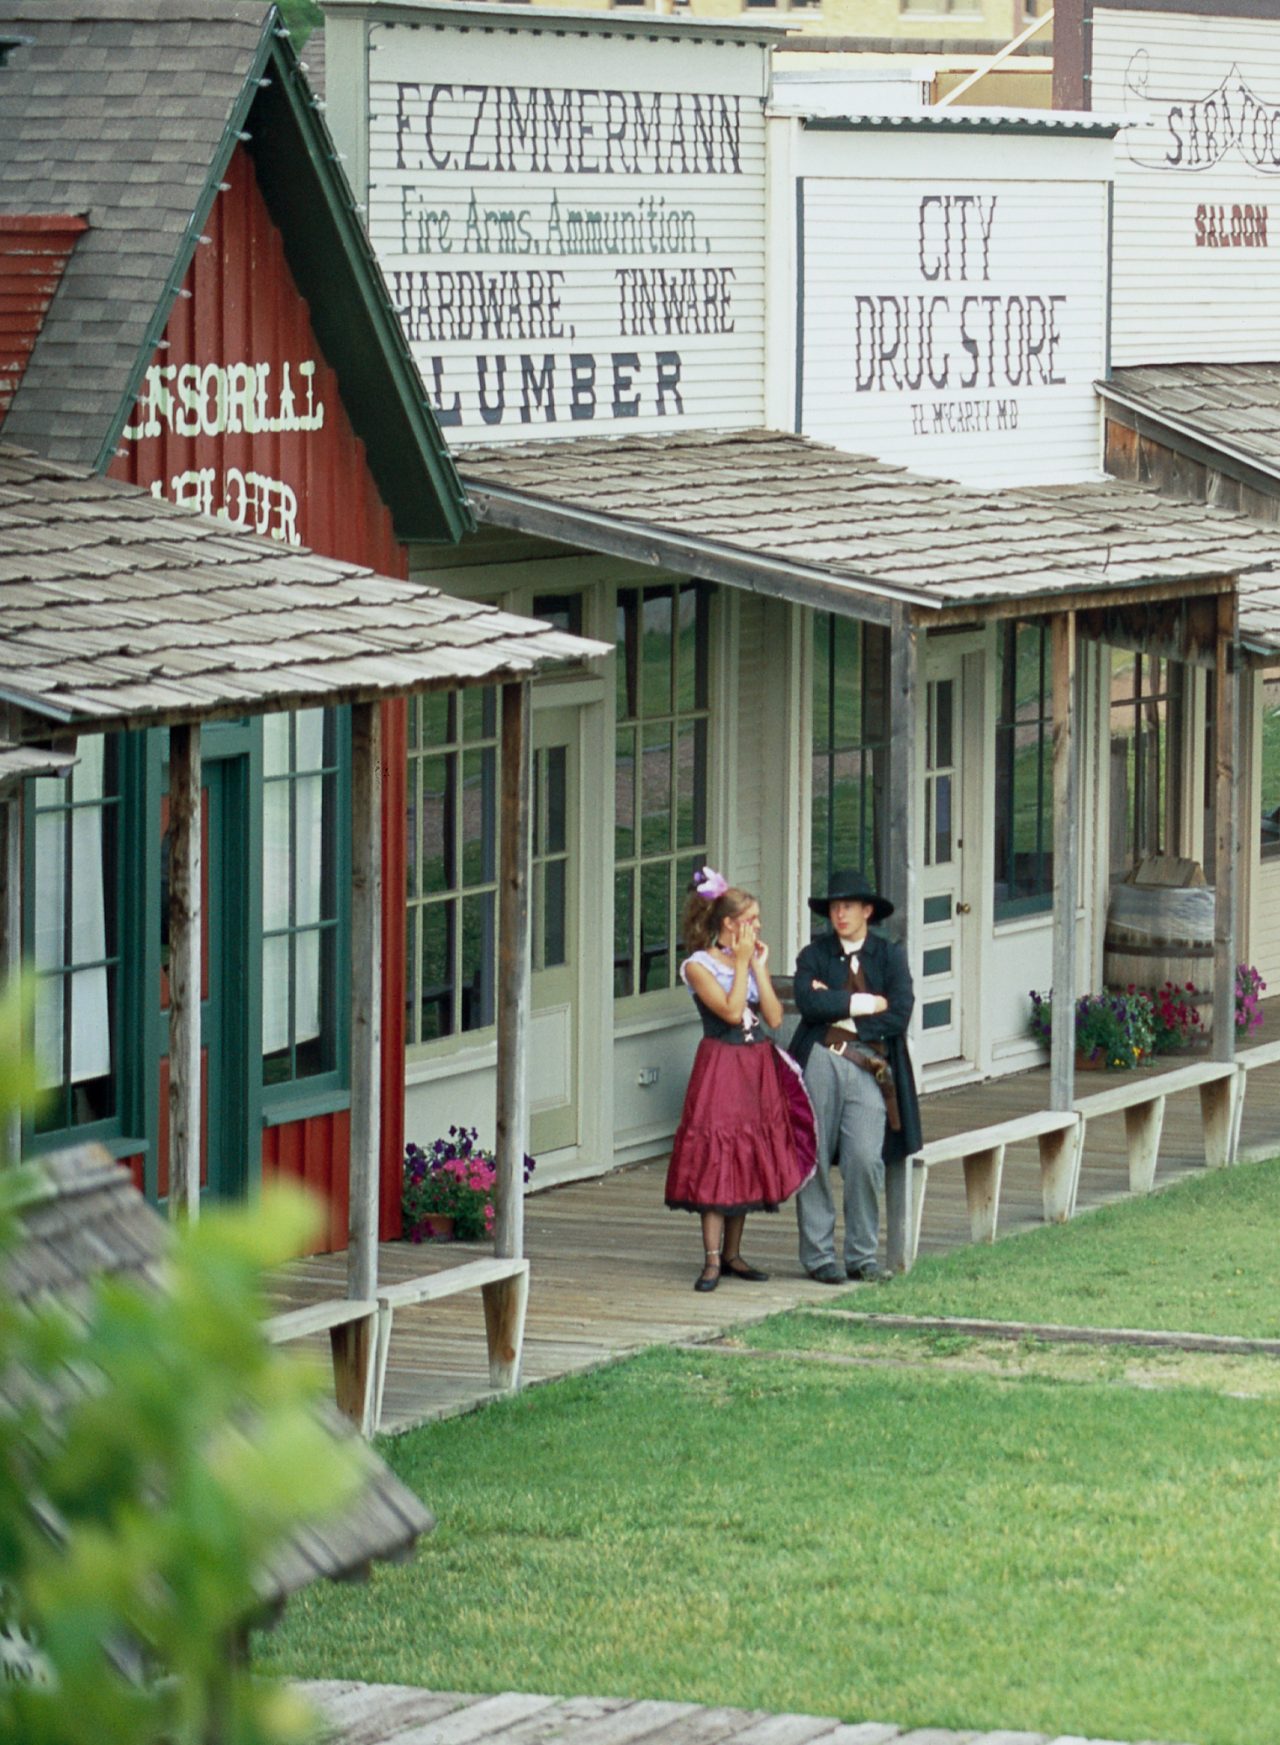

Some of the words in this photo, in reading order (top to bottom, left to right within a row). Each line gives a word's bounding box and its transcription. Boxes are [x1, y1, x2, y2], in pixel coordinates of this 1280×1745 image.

[401, 185, 453, 255] Fire
[919, 195, 998, 281] CITY
[1195, 203, 1269, 248] SALOON
[615, 267, 737, 336] TINWARE
[855, 295, 950, 392] DRUG
[960, 294, 1067, 389] STORE
[431, 351, 684, 427] LUMBER
